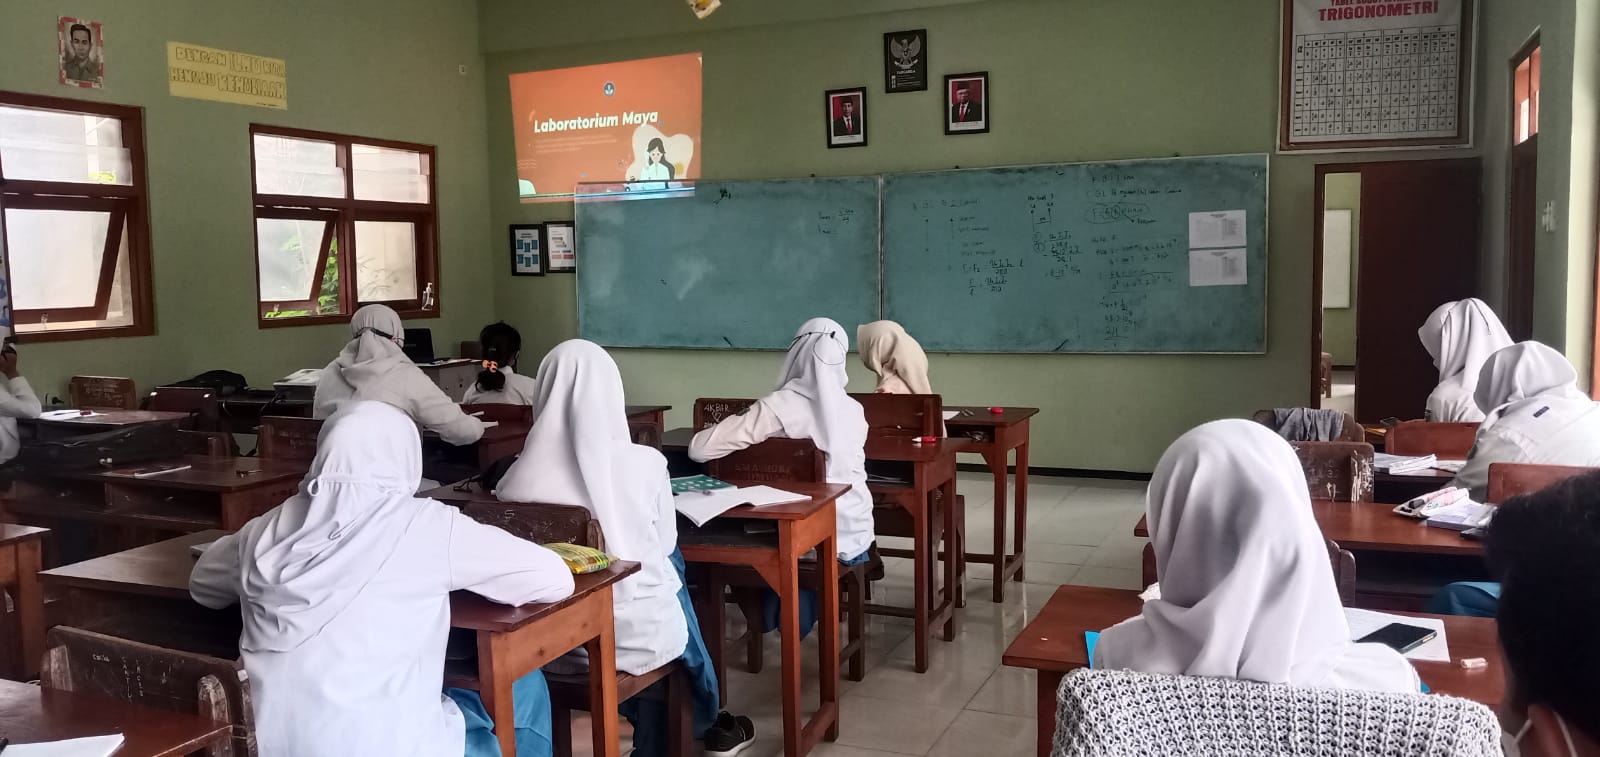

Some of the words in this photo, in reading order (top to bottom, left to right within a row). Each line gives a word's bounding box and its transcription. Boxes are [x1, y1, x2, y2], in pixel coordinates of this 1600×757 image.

[1318, 1, 1439, 21] TRIGONOMETRI
[176, 47, 227, 65] DENGAN
[229, 52, 262, 73] ILMU
[217, 72, 285, 99] KEMULIAAN
[534, 113, 619, 134] Laboratorium
[622, 110, 659, 128] Maya
[704, 403, 730, 413] AKBAR
